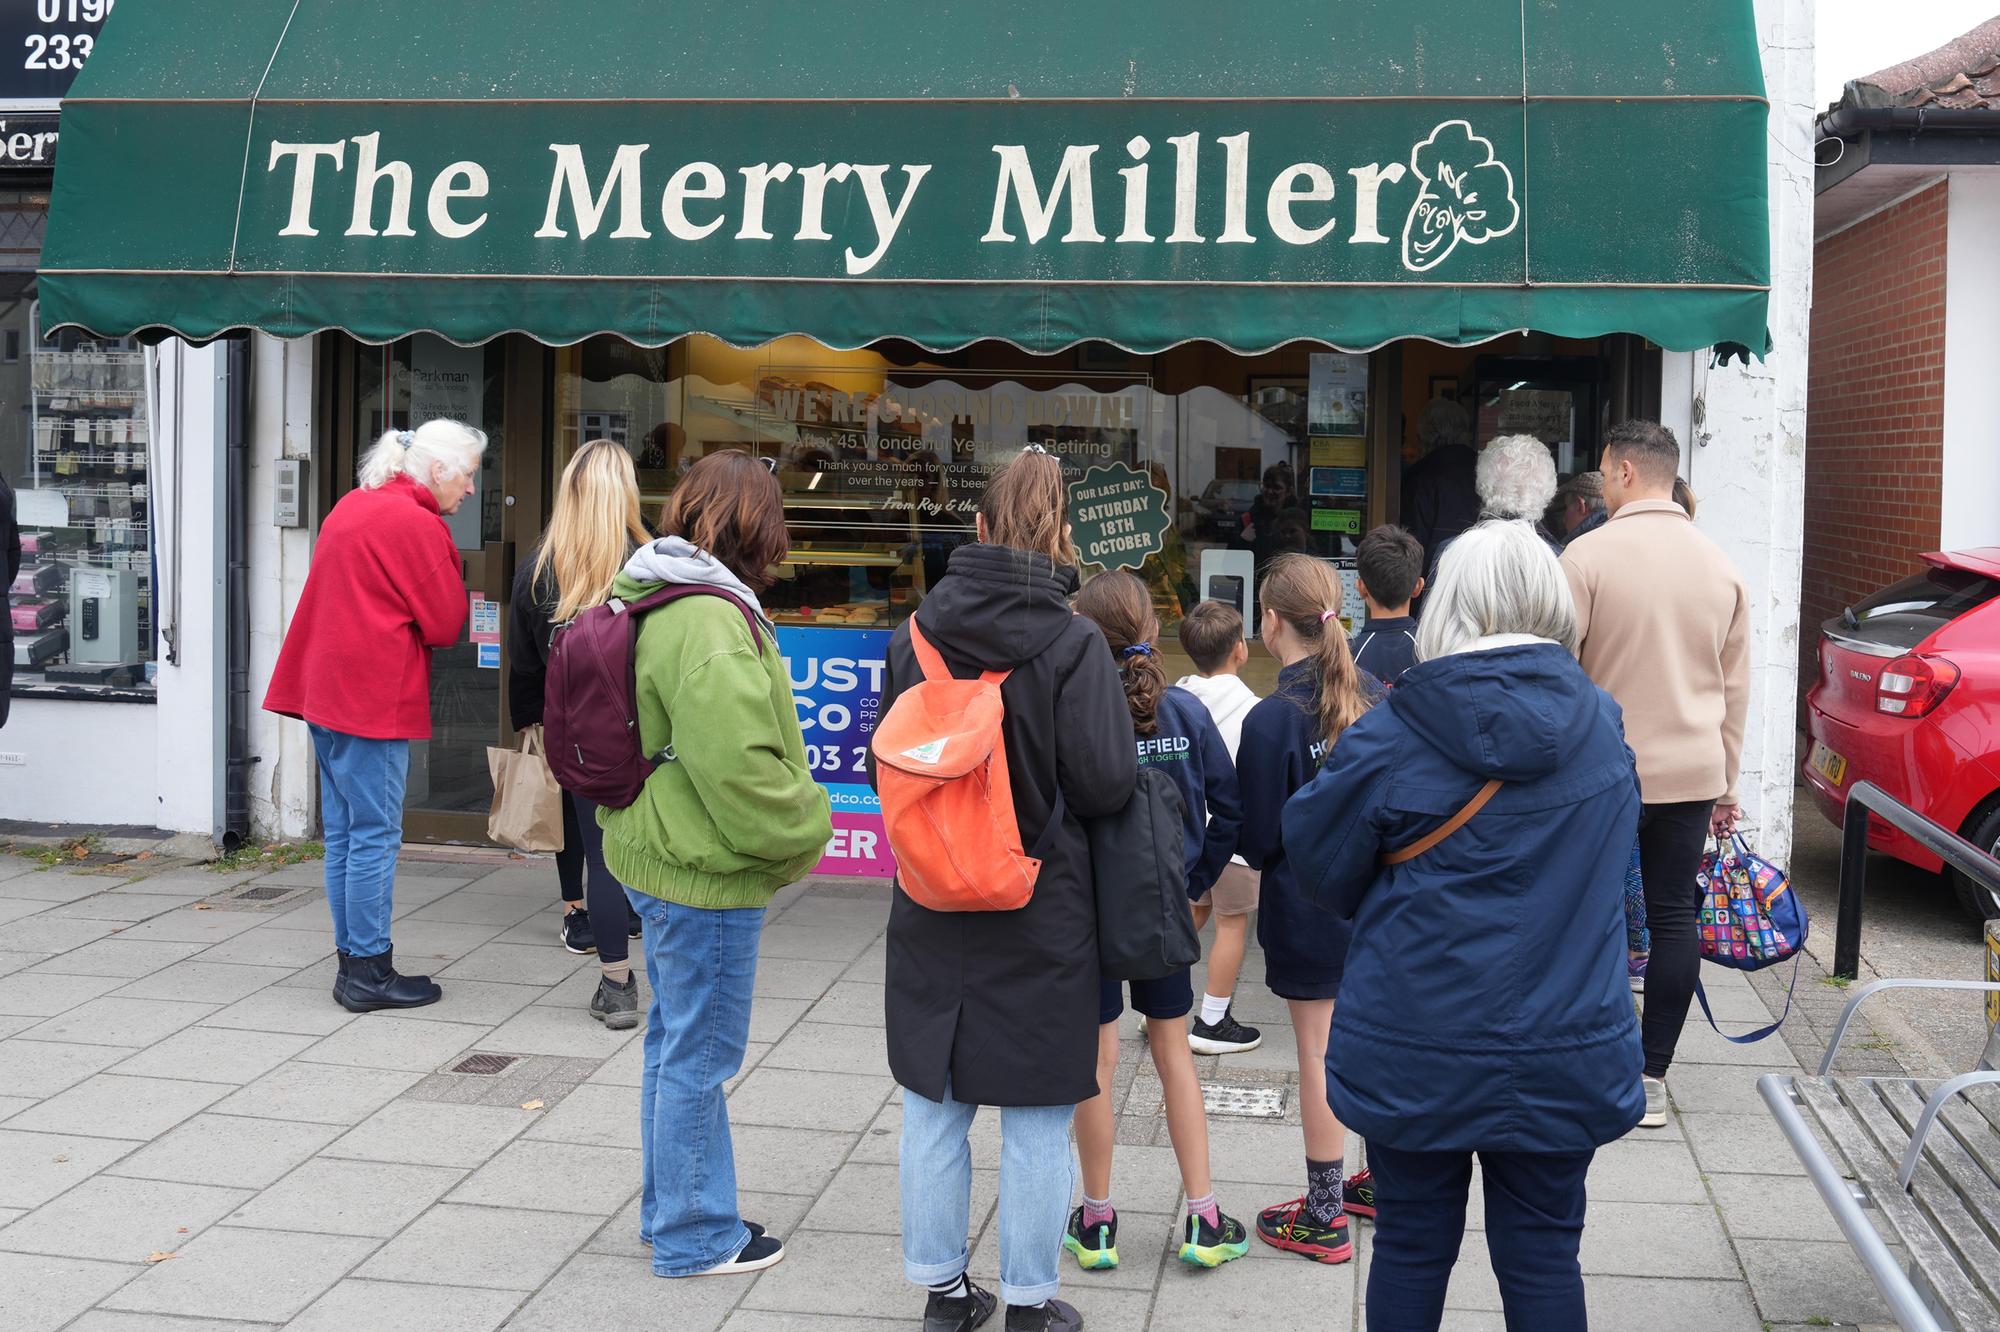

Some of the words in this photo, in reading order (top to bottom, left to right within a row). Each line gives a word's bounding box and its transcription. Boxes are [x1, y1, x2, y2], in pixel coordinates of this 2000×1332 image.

[38, 0, 114, 23] 019
[25, 34, 94, 69] 233
[268, 131, 490, 239] The
[534, 143, 932, 275] Merry
[979, 131, 1407, 245] Miller
[414, 368, 469, 383] Parkman
[773, 389, 869, 423] WE'RE
[877, 391, 1014, 426] CLOSING
[1025, 394, 1134, 429] DOWN!
[791, 432, 833, 449] After
[836, 434, 858, 449] 45
[862, 434, 949, 452] Wonderful
[1044, 438, 1113, 458] Retiring
[817, 459, 850, 471] Thank
[852, 462, 873, 473] you
[875, 462, 889, 471] so
[891, 461, 923, 472] much
[925, 461, 941, 472] for
[943, 463, 967, 475] your
[970, 464, 997, 476] supp
[848, 477, 872, 486] over
[875, 476, 892, 486] the
[895, 477, 925, 489] years
[943, 476, 958, 487] it's
[1076, 488, 1097, 501] OUR
[1098, 483, 1121, 497] LAST
[1122, 479, 1145, 492] DAY:
[881, 496, 915, 511] From
[917, 497, 943, 516] Roy
[957, 499, 979, 512] the
[1078, 495, 1149, 523] SATURDAY
[1100, 517, 1135, 537] 18TH
[1090, 532, 1152, 557] OCTOBER
